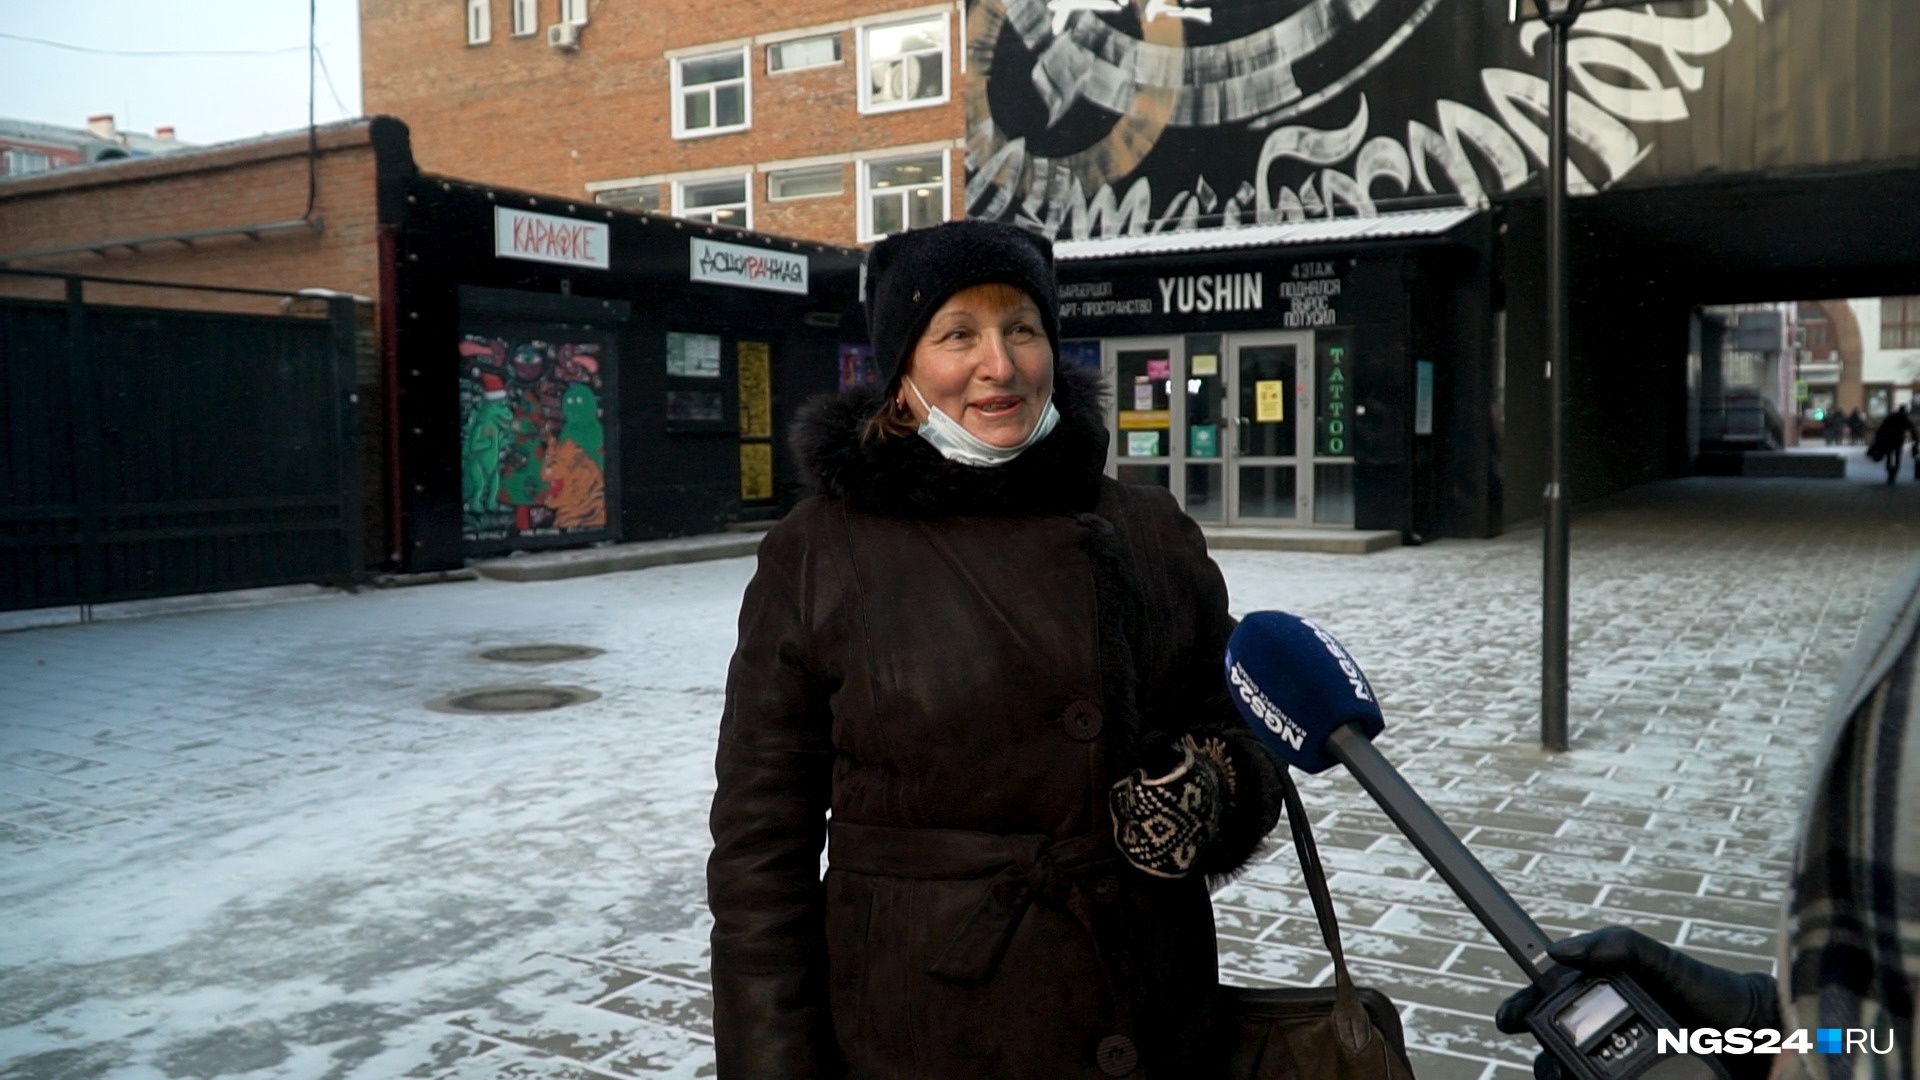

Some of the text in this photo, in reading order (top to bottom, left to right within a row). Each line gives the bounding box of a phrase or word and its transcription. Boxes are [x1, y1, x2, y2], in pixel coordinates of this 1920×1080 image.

[513, 215, 597, 260] КАРАОКЕ
[1291, 261, 1336, 278] 4 ЭТАЖ
[1158, 272, 1263, 313] YUSHIN
[1280, 279, 1342, 298] ПОДНЯЛСЯ
[1290, 296, 1329, 311] ВЫРОС
[1283, 308, 1337, 327] ПОТУСИЛ
[1328, 346, 1345, 454] TATTOO
[1230, 665, 1305, 752] NGS24
